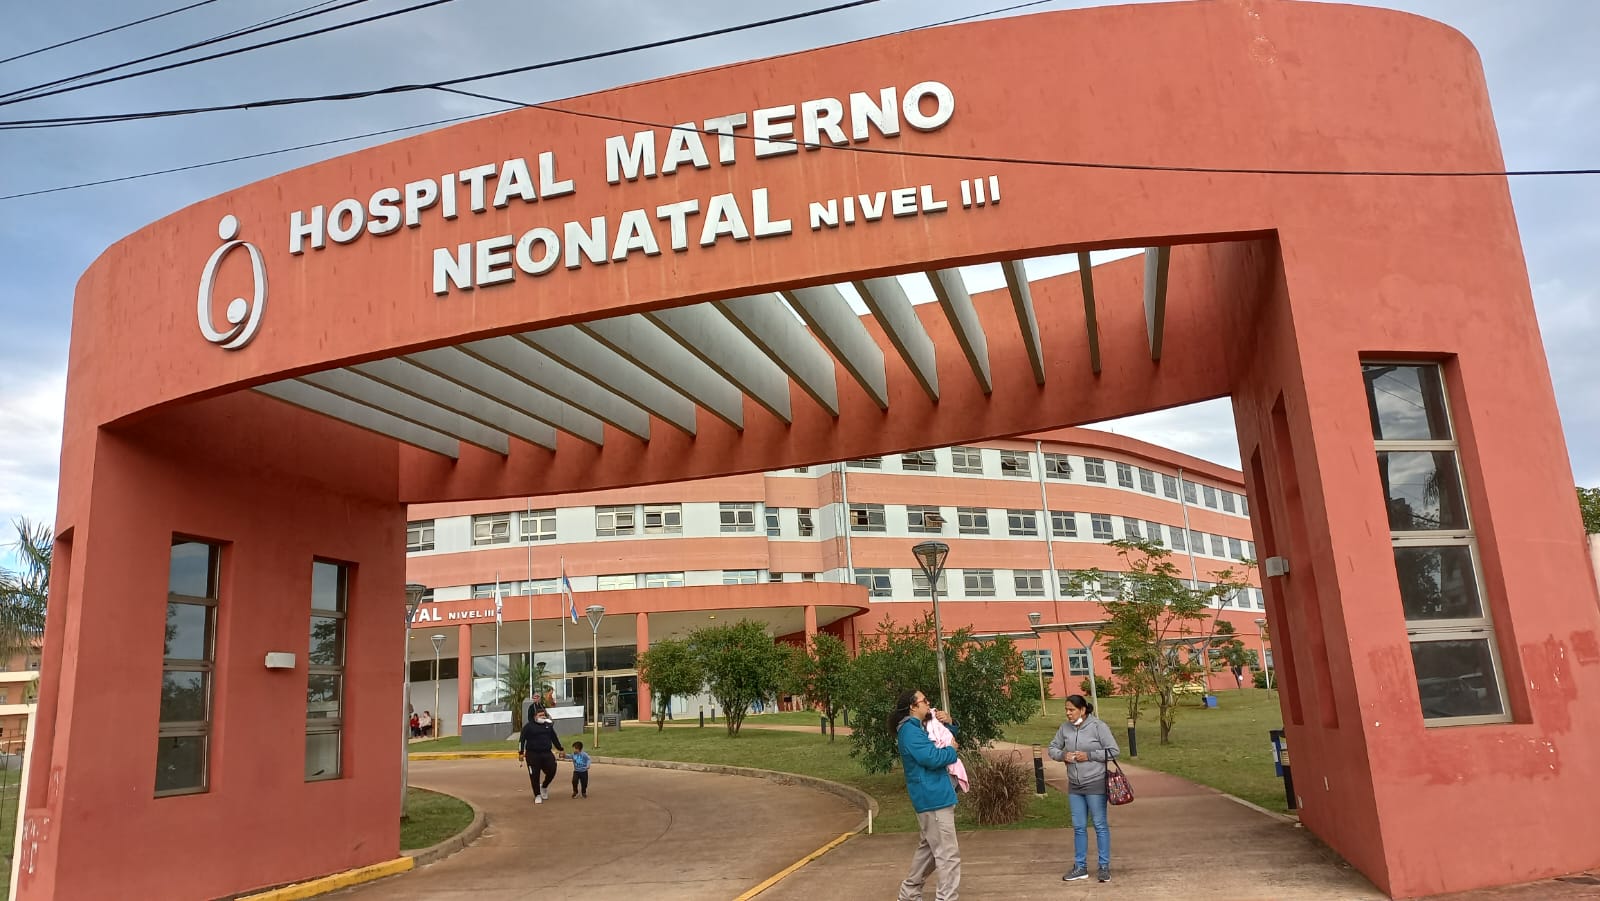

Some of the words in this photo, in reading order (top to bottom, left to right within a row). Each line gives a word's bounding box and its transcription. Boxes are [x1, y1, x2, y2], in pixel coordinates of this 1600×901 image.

[288, 151, 576, 255] HOSPITAL
[605, 81, 955, 185] MATERNO
[432, 188, 793, 296] NEONATAL
[810, 184, 948, 230] NIVEL
[961, 175, 1003, 210] III
[448, 610, 482, 620] NIVEL
[484, 609, 494, 617] III
